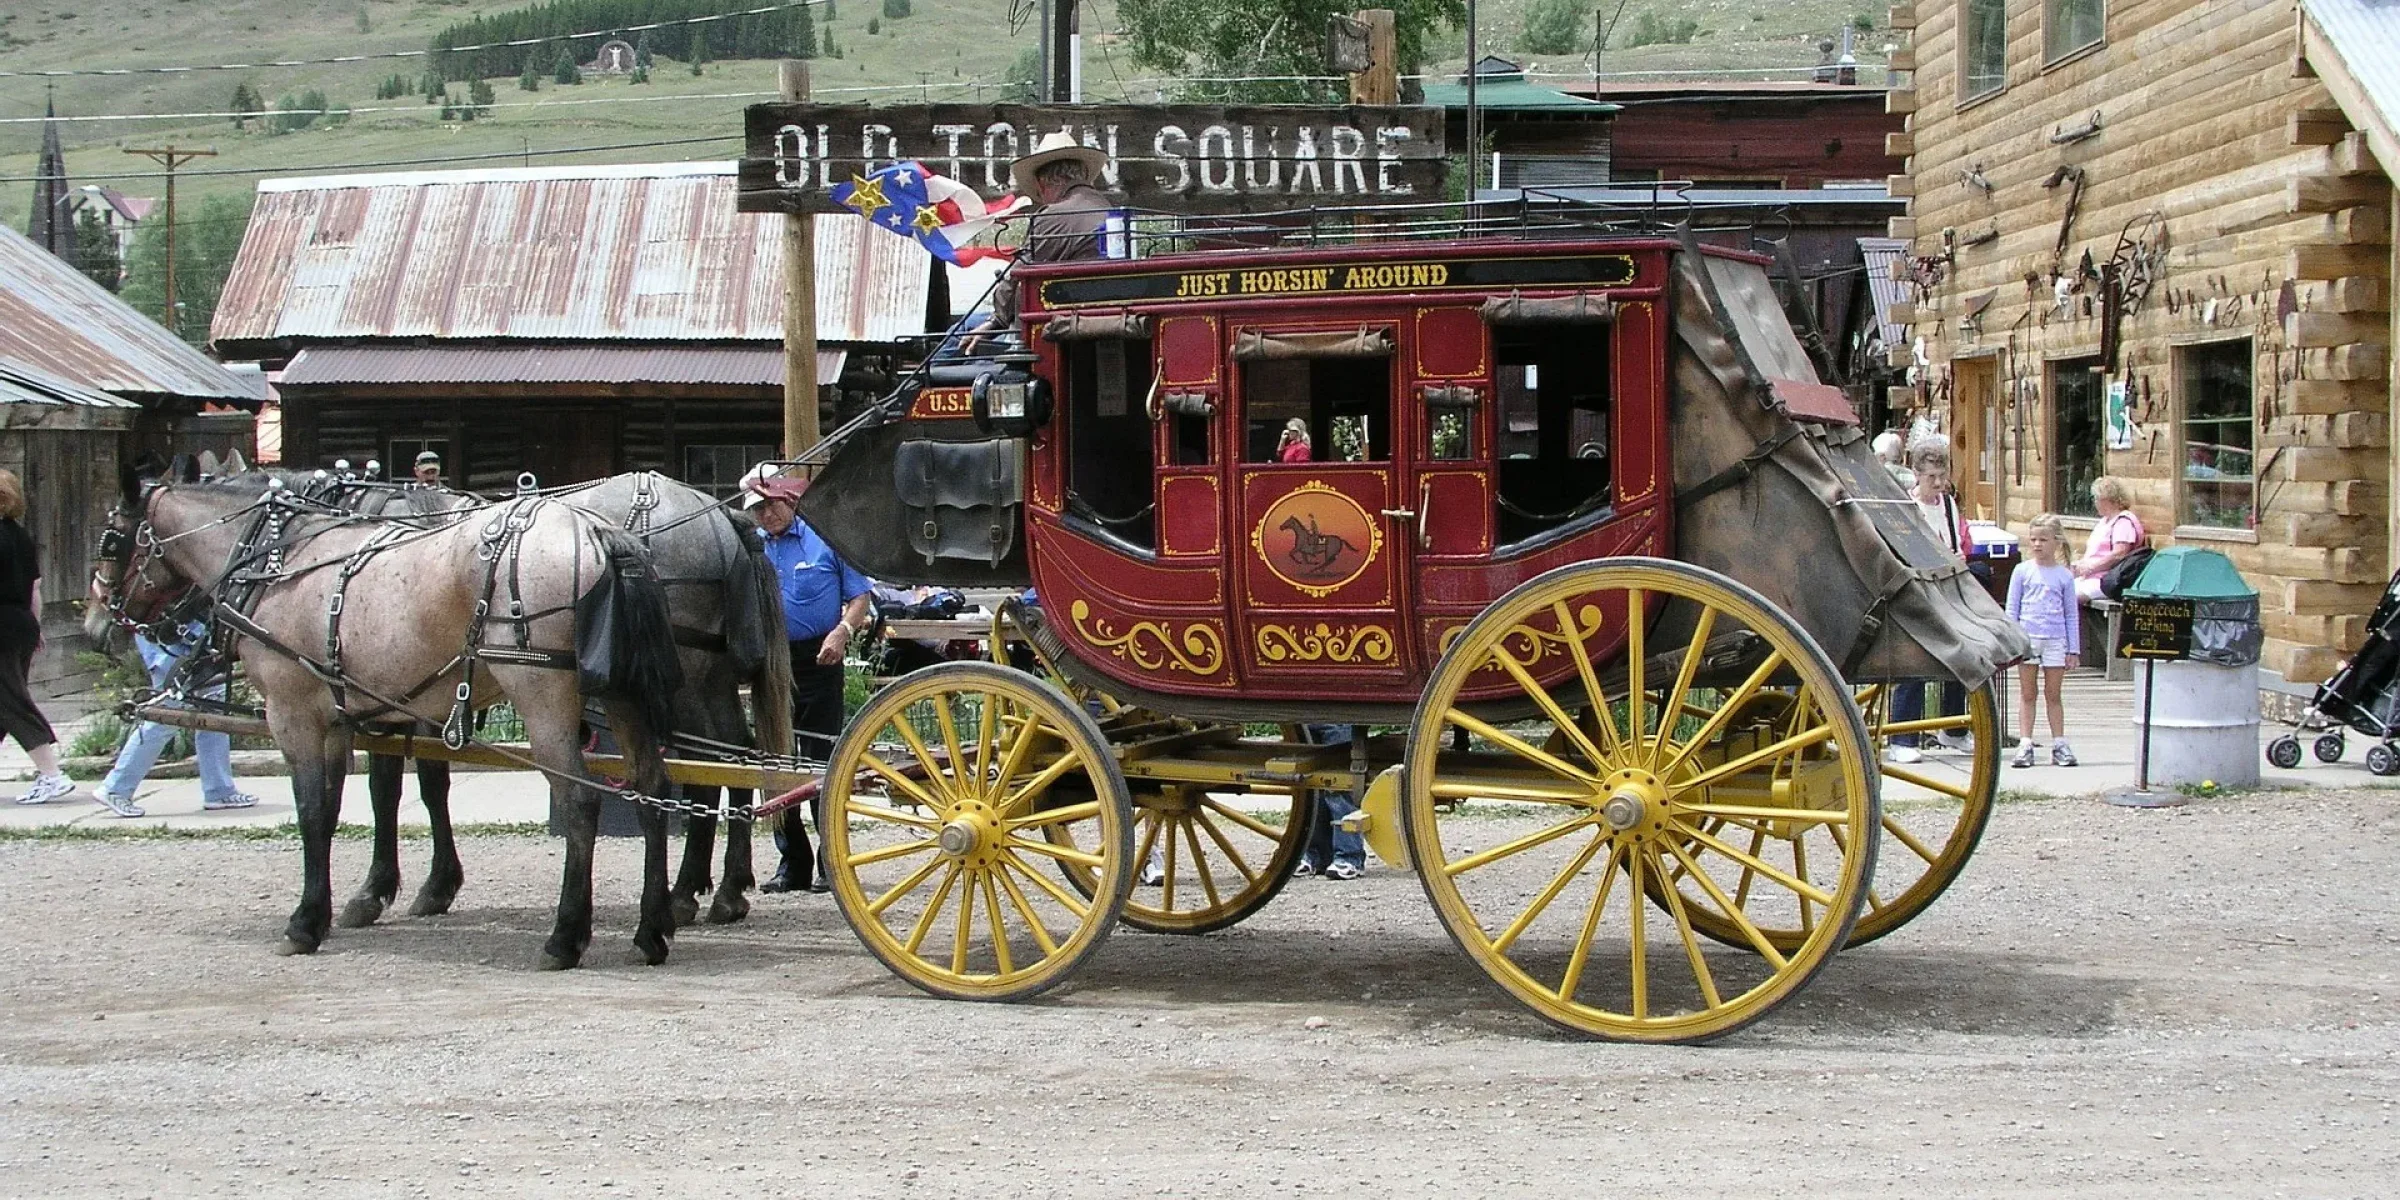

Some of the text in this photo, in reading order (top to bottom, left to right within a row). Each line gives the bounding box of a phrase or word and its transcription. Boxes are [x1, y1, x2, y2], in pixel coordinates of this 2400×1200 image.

[774, 122, 1414, 194] OLD TON SQUARE
[1177, 264, 1449, 296] JUST HORSIN' AROUND
